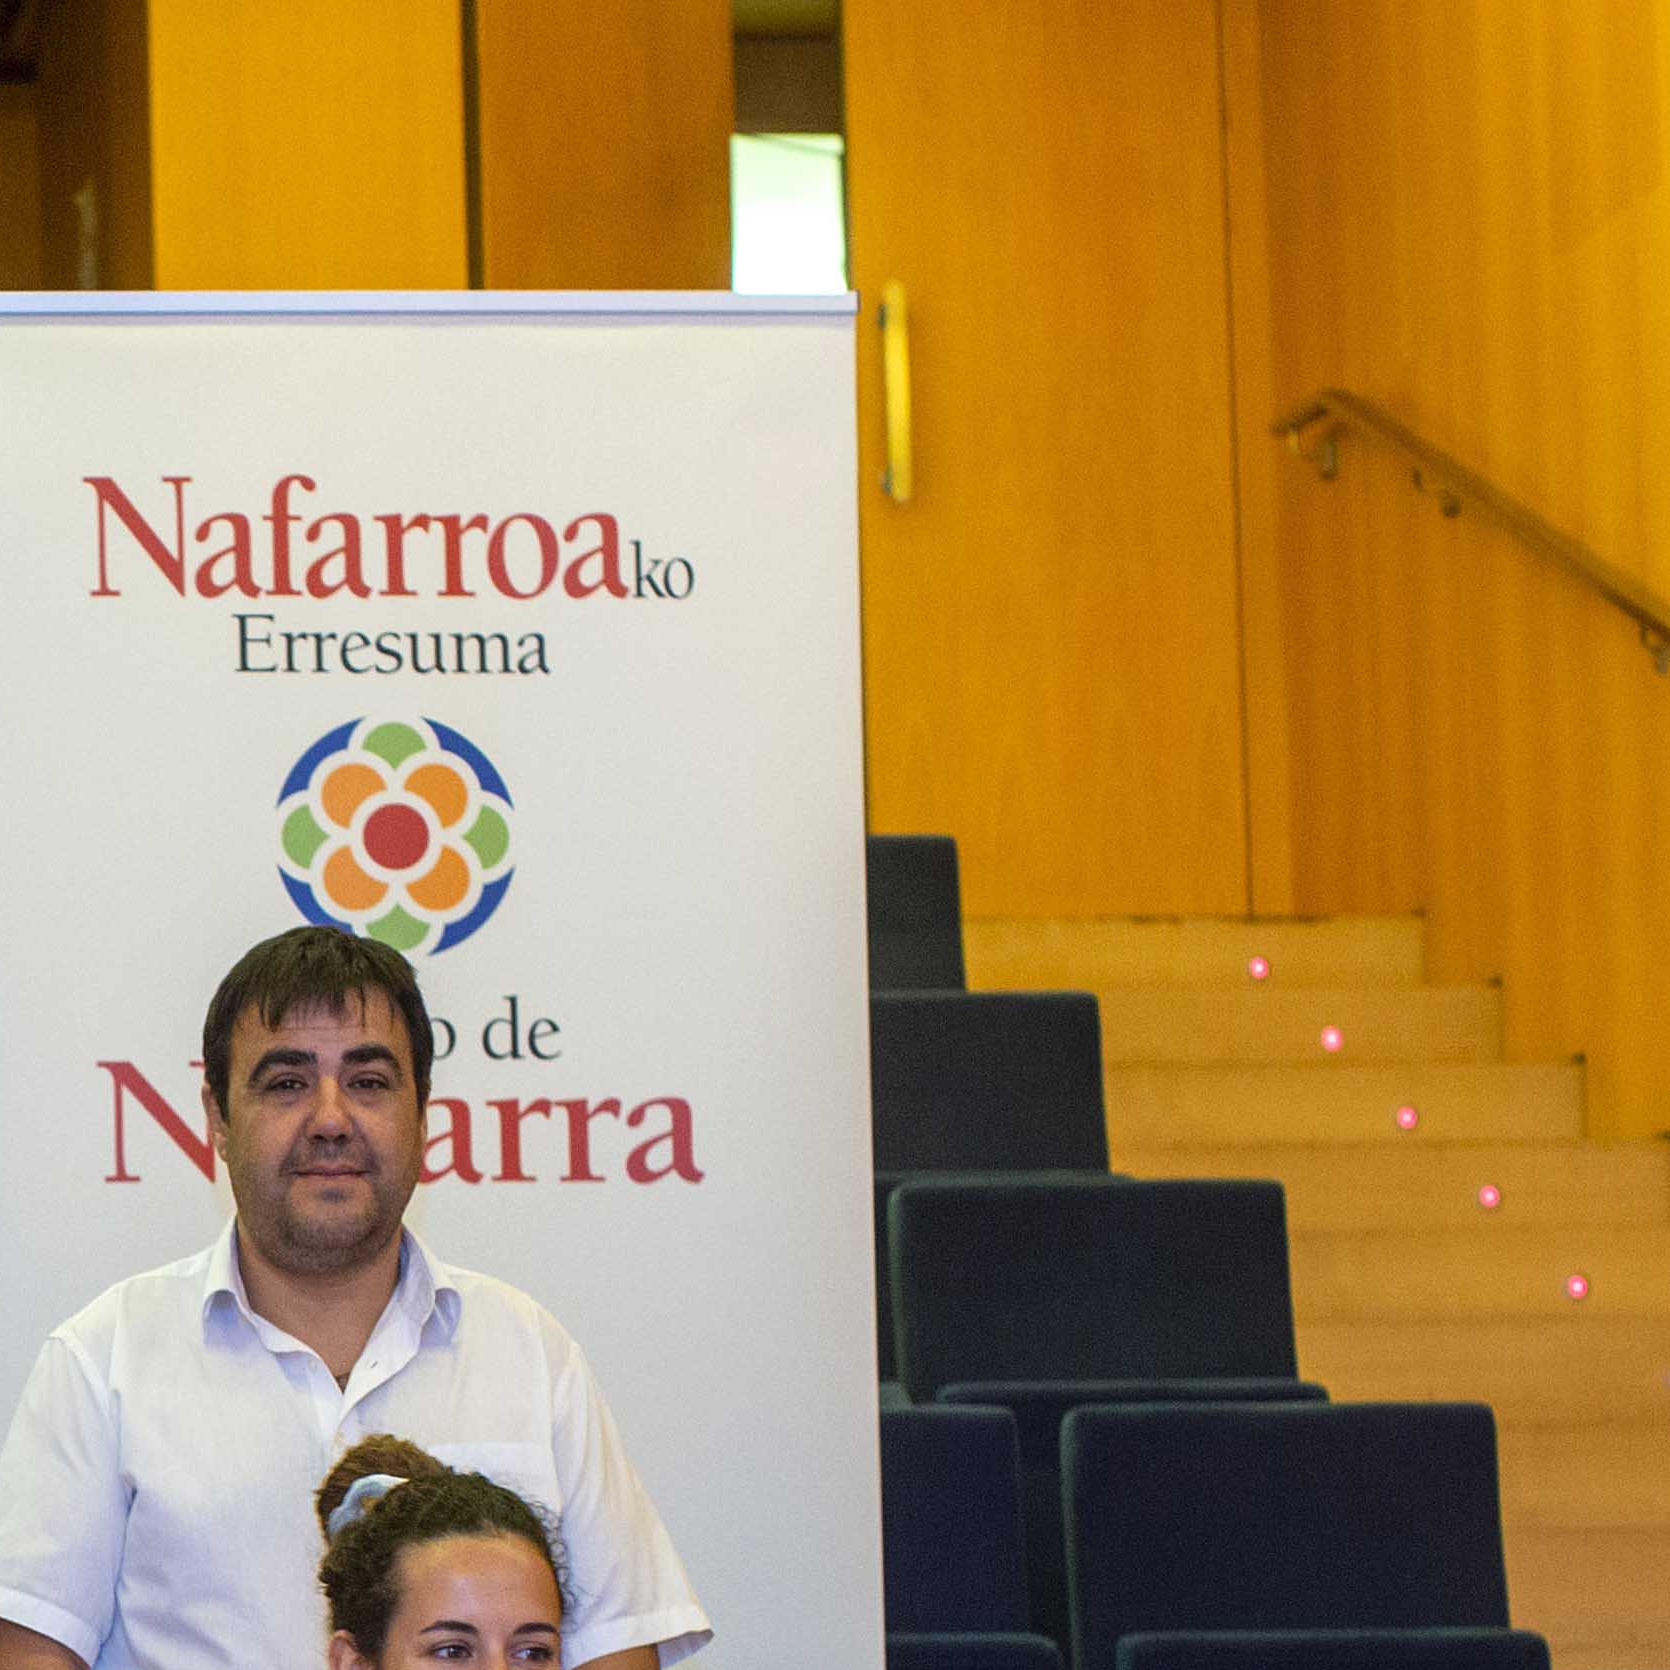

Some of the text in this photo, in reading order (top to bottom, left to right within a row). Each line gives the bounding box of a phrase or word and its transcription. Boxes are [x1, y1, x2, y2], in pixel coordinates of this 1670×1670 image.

[232, 612, 550, 674] Erresuma
[482, 994, 563, 1061] de
[95, 1060, 705, 1185] Narra
